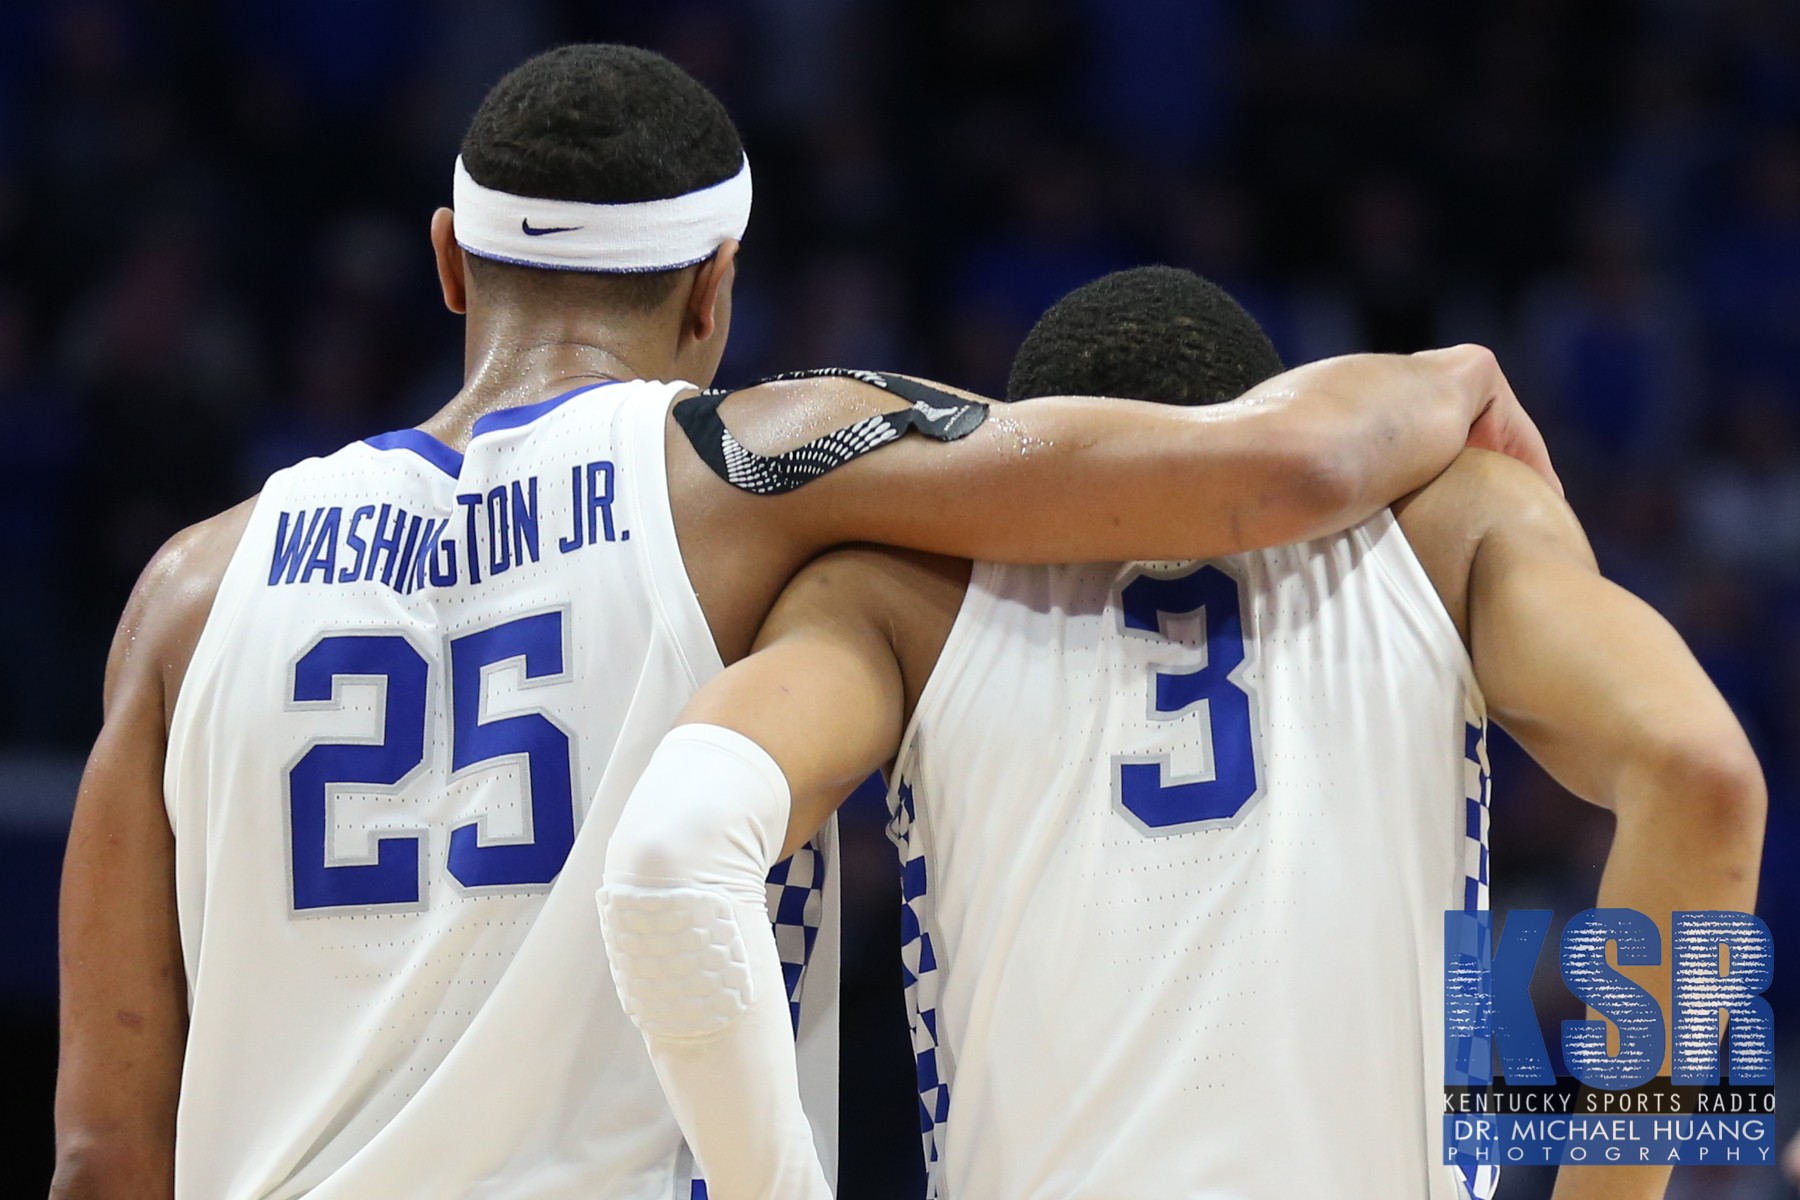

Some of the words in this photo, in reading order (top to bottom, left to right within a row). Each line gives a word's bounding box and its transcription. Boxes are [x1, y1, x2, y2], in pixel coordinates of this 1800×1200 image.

[267, 476, 540, 595] WASHINGTON
[558, 460, 631, 554] JR.
[280, 602, 582, 920] 25
[1110, 560, 1268, 838] 3
